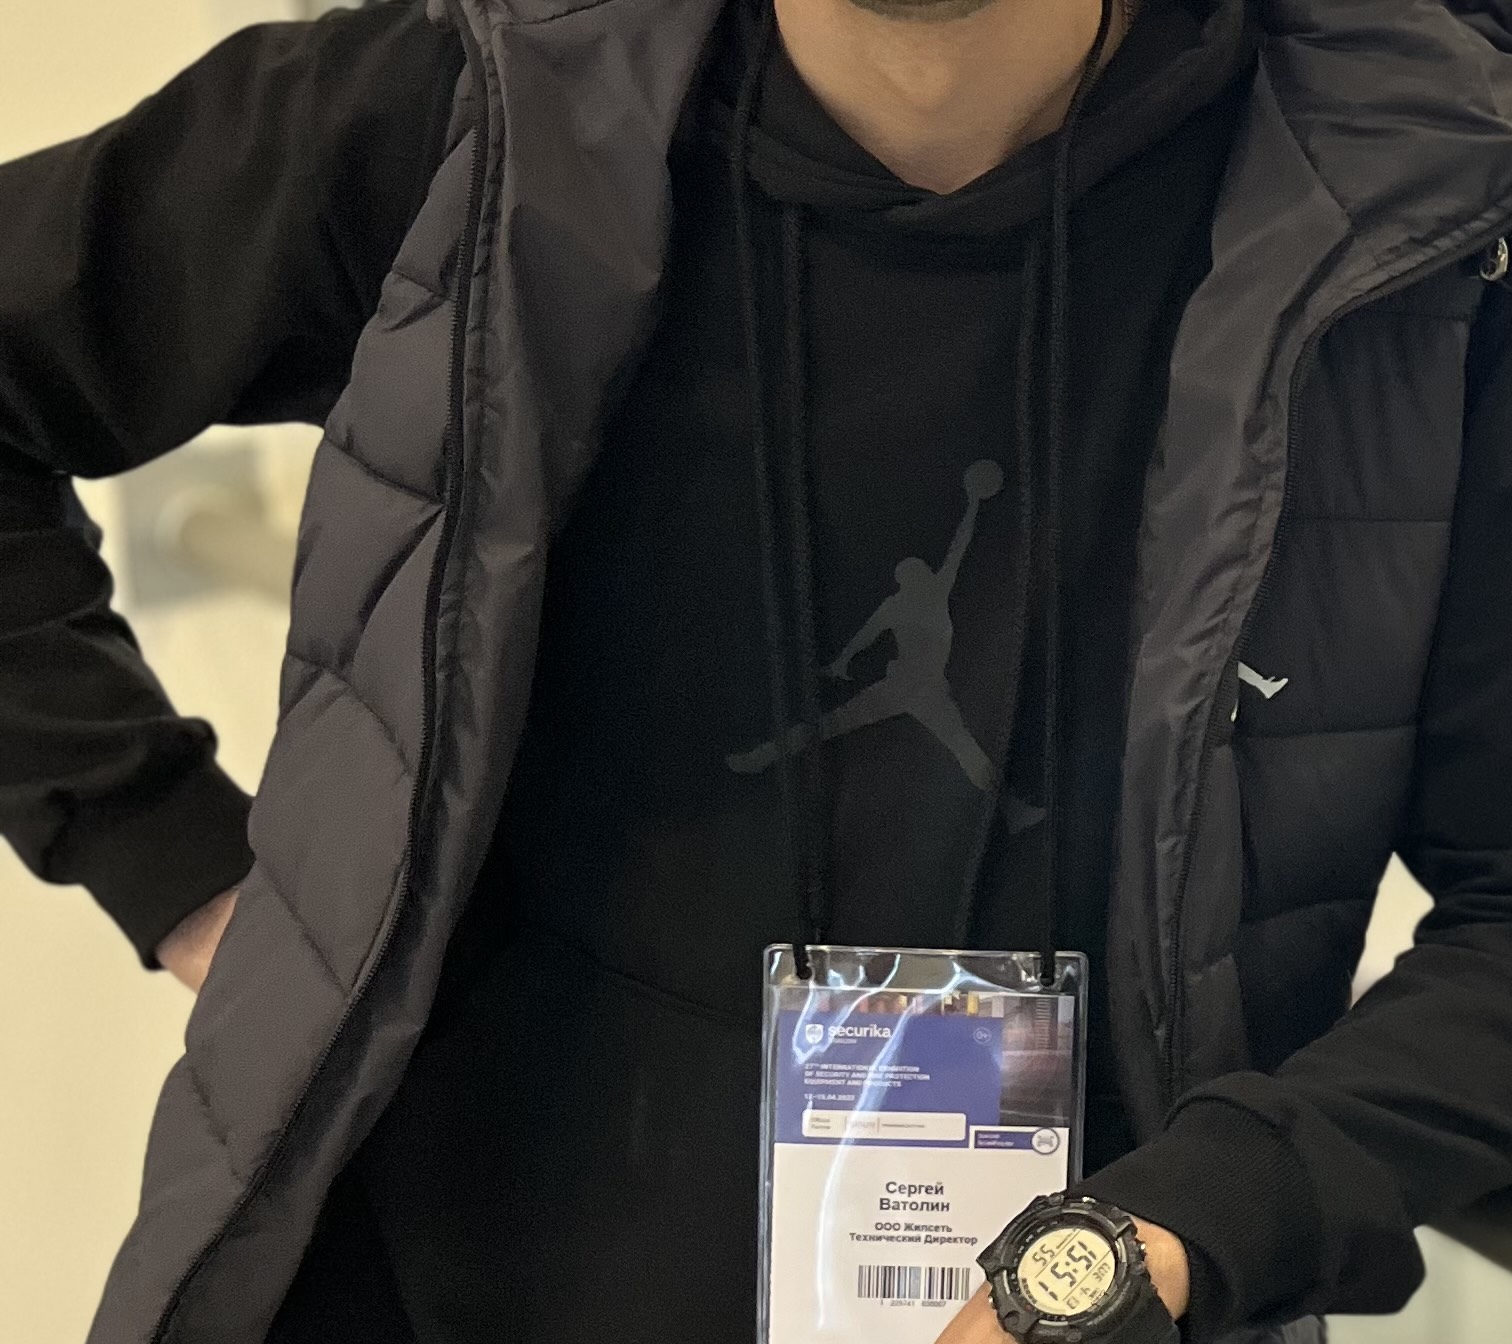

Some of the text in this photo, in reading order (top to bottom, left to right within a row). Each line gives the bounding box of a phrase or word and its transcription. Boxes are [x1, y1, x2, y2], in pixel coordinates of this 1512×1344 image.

[828, 1023, 892, 1038] securika
[885, 1181, 944, 1197] Сергей
[879, 1197, 950, 1212] Ватолин
[874, 1222, 953, 1233] ООО Жилсеть
[849, 1232, 978, 1246] Технический Директор
[1032, 1243, 1056, 1267] 55
[1038, 1240, 1097, 1302] 15:51
